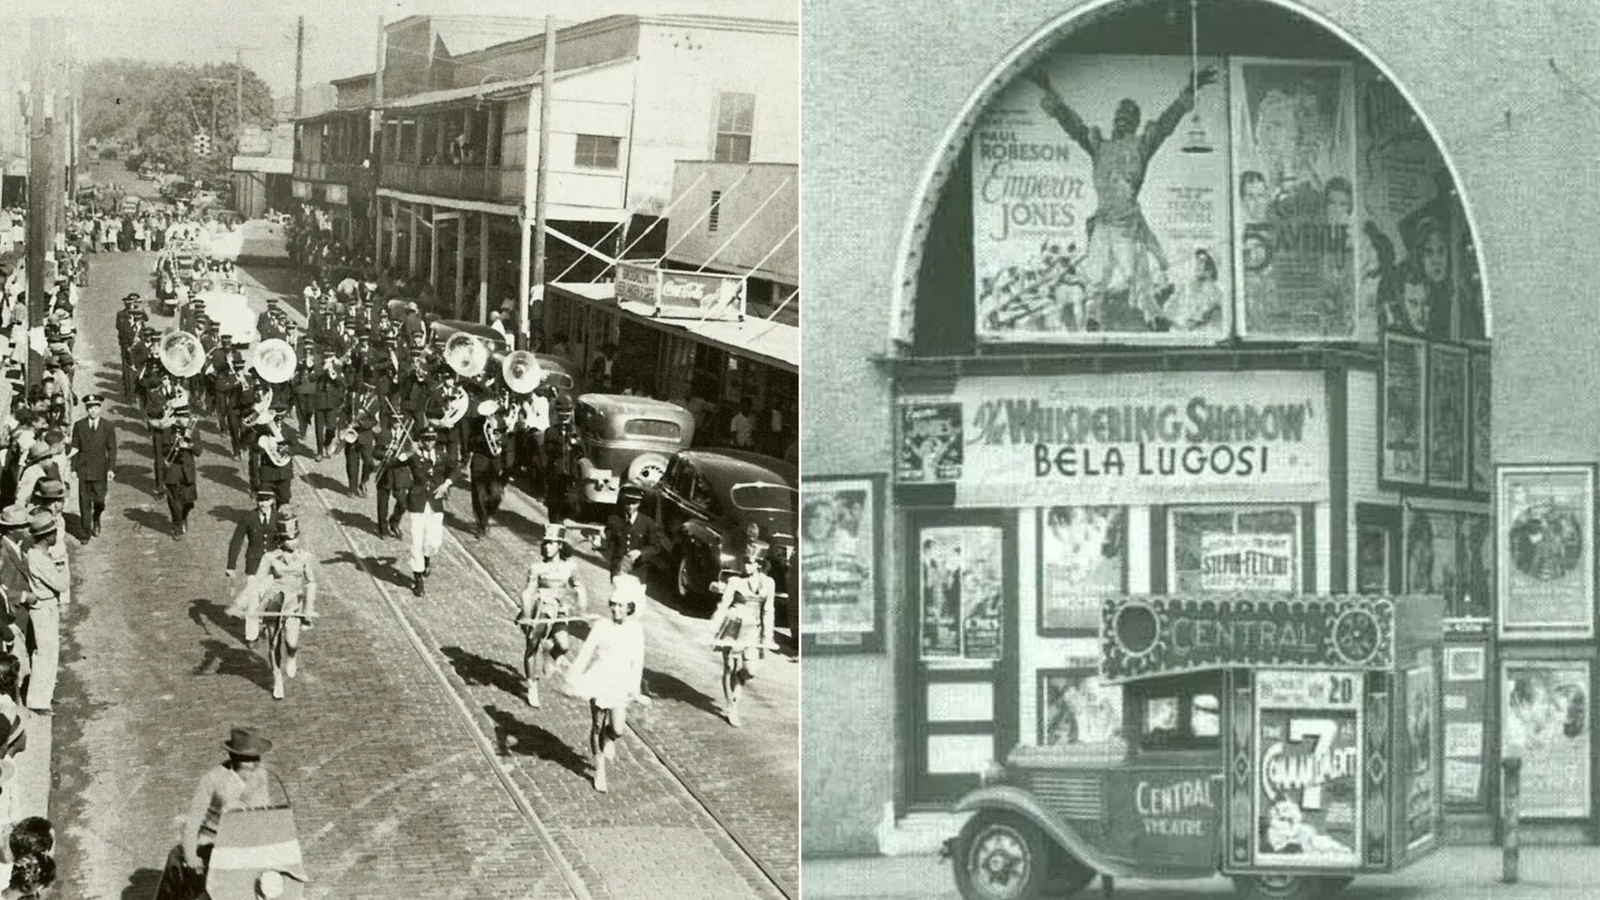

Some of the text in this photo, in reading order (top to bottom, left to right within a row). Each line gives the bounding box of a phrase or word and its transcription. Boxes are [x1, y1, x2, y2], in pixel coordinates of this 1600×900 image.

[980, 142, 1069, 161] ROBESON
[989, 202, 1075, 241] JONES
[1034, 441, 1268, 477] BELA LUGOSI
[1171, 616, 1319, 653] CENTRAL
[1328, 674, 1353, 704] 20
[1289, 718, 1338, 810] 7
[1135, 777, 1215, 815] CENTRAL
[1142, 818, 1206, 836] THEATRE
